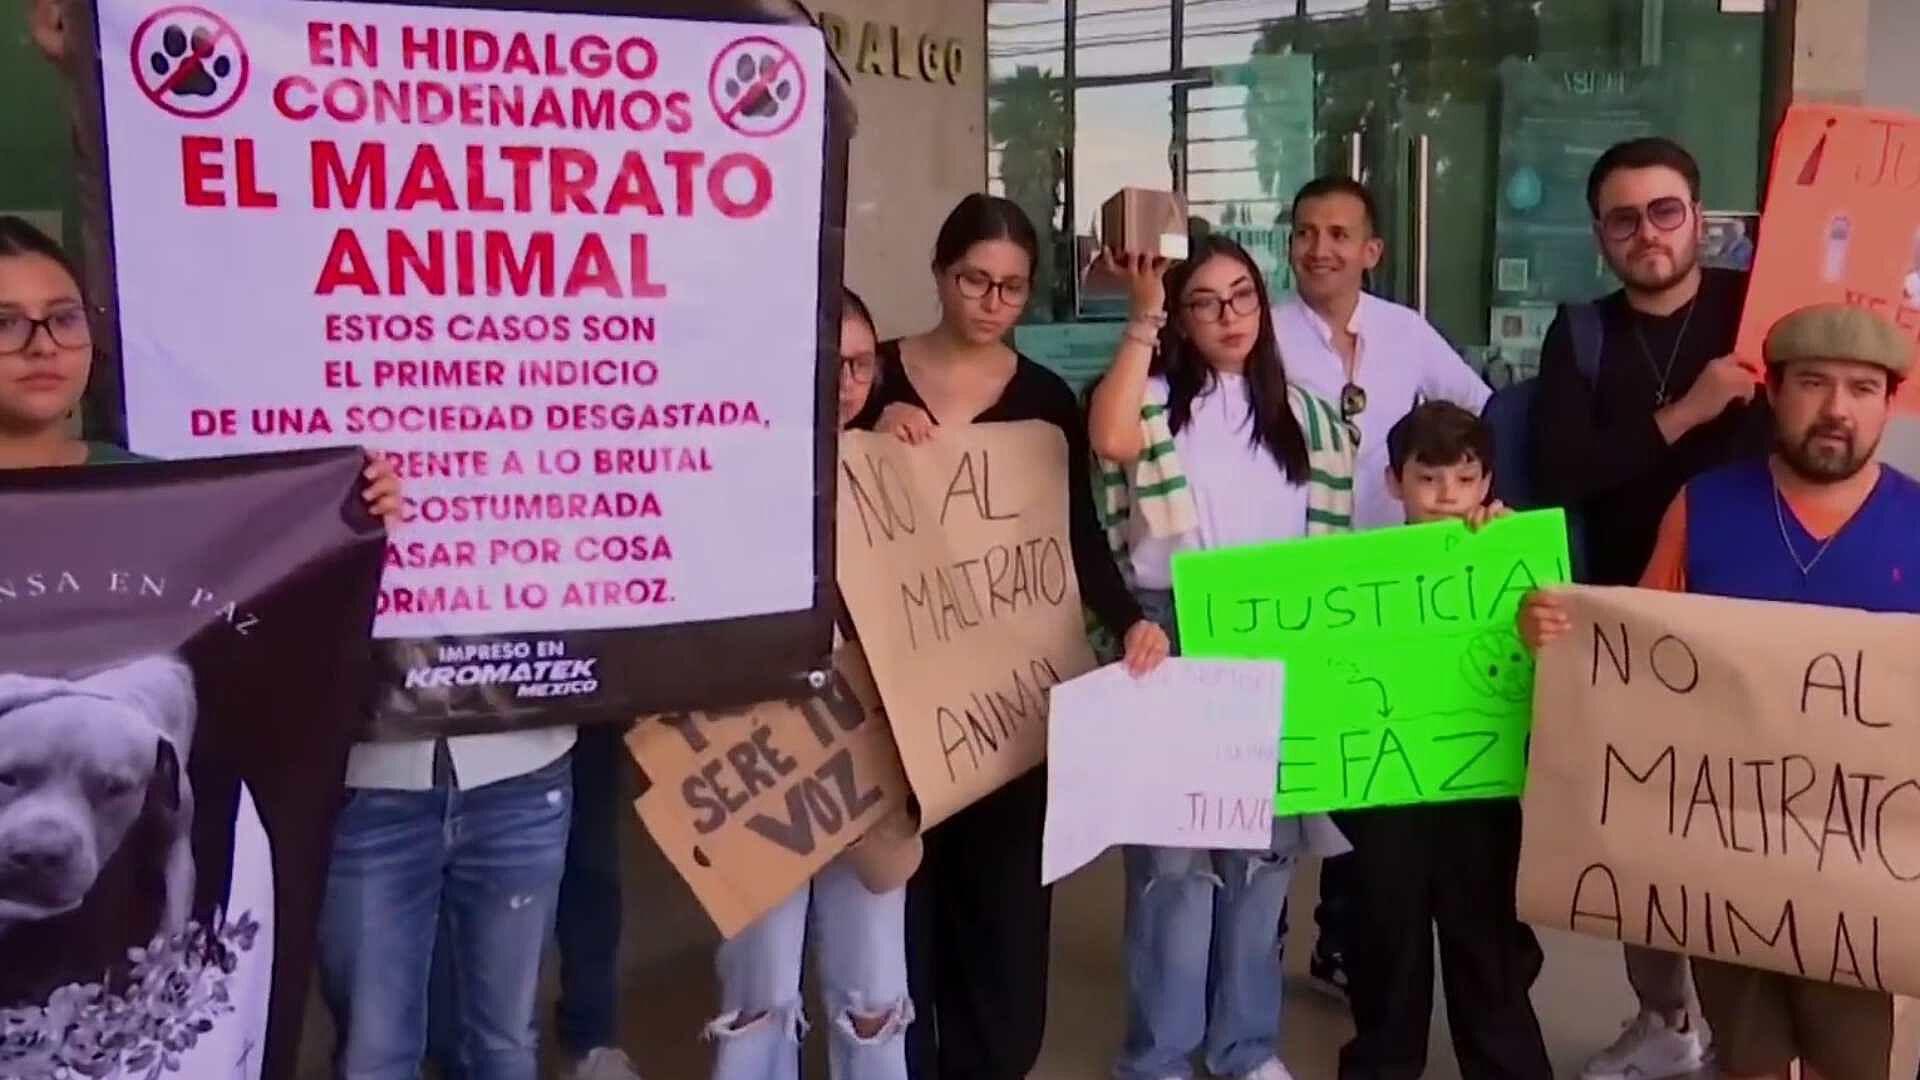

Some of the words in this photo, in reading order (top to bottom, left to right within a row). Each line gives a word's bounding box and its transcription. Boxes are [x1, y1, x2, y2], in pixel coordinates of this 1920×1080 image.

[308, 21, 378, 69] EN
[401, 26, 659, 80] HIDALGO
[272, 76, 692, 133] CONDENAMOS
[180, 134, 278, 208] EL
[311, 140, 774, 219] MALTRATO
[314, 228, 668, 299] ANIMAL
[325, 314, 434, 342] ESTOS
[447, 314, 570, 342] CASOS
[583, 315, 656, 342] SON
[325, 360, 362, 388] EL
[373, 360, 505, 388] PRIMER
[518, 359, 659, 387] INDICIO
[191, 408, 238, 437] DE
[251, 406, 333, 435] UNA
[345, 405, 533, 433] SOCIEDAD
[384, 451, 489, 478] RENTE
[502, 450, 524, 475] A
[539, 449, 581, 475] LO
[594, 446, 713, 475] BRUTAL
[400, 492, 662, 523] COSTUMBRADA
[842, 453, 916, 548] NO
[940, 449, 1021, 526] AL
[383, 541, 476, 569] ASAR
[489, 538, 561, 565] POR
[575, 535, 673, 563] COSA
[110, 569, 167, 597] EN
[190, 587, 260, 636] PAZ
[376, 585, 491, 616] ORMAL
[505, 582, 547, 610] LO
[562, 578, 676, 607] ATROZ.
[900, 536, 1067, 652] MALTRATO
[404, 657, 597, 688] KROMATEK
[439, 641, 531, 663] IMPRESO
[536, 640, 566, 658] EN
[1592, 622, 1698, 694] NO
[1801, 649, 1892, 727] AL
[516, 679, 598, 697] MEXICO
[745, 748, 884, 856] VOZ
[1601, 743, 1920, 882] MALTRATO
